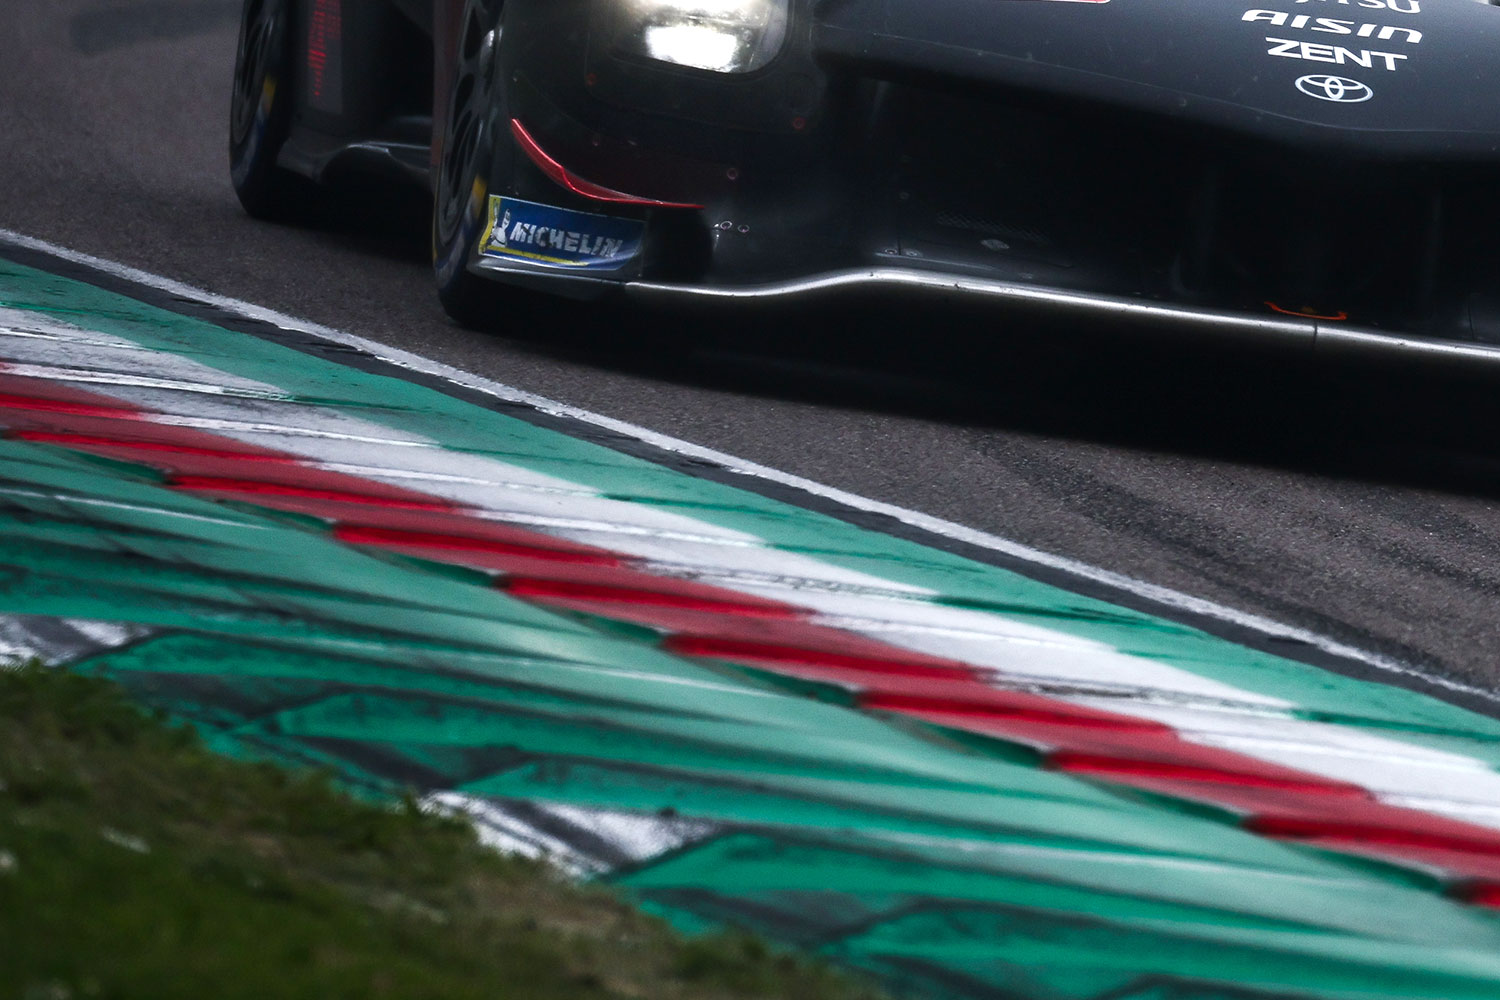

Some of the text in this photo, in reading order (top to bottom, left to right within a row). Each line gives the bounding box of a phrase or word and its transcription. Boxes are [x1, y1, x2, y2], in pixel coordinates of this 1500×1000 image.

[1241, 9, 1423, 44] AISIN
[1265, 36, 1408, 71] ZENT
[510, 221, 623, 259] MICHELIN
